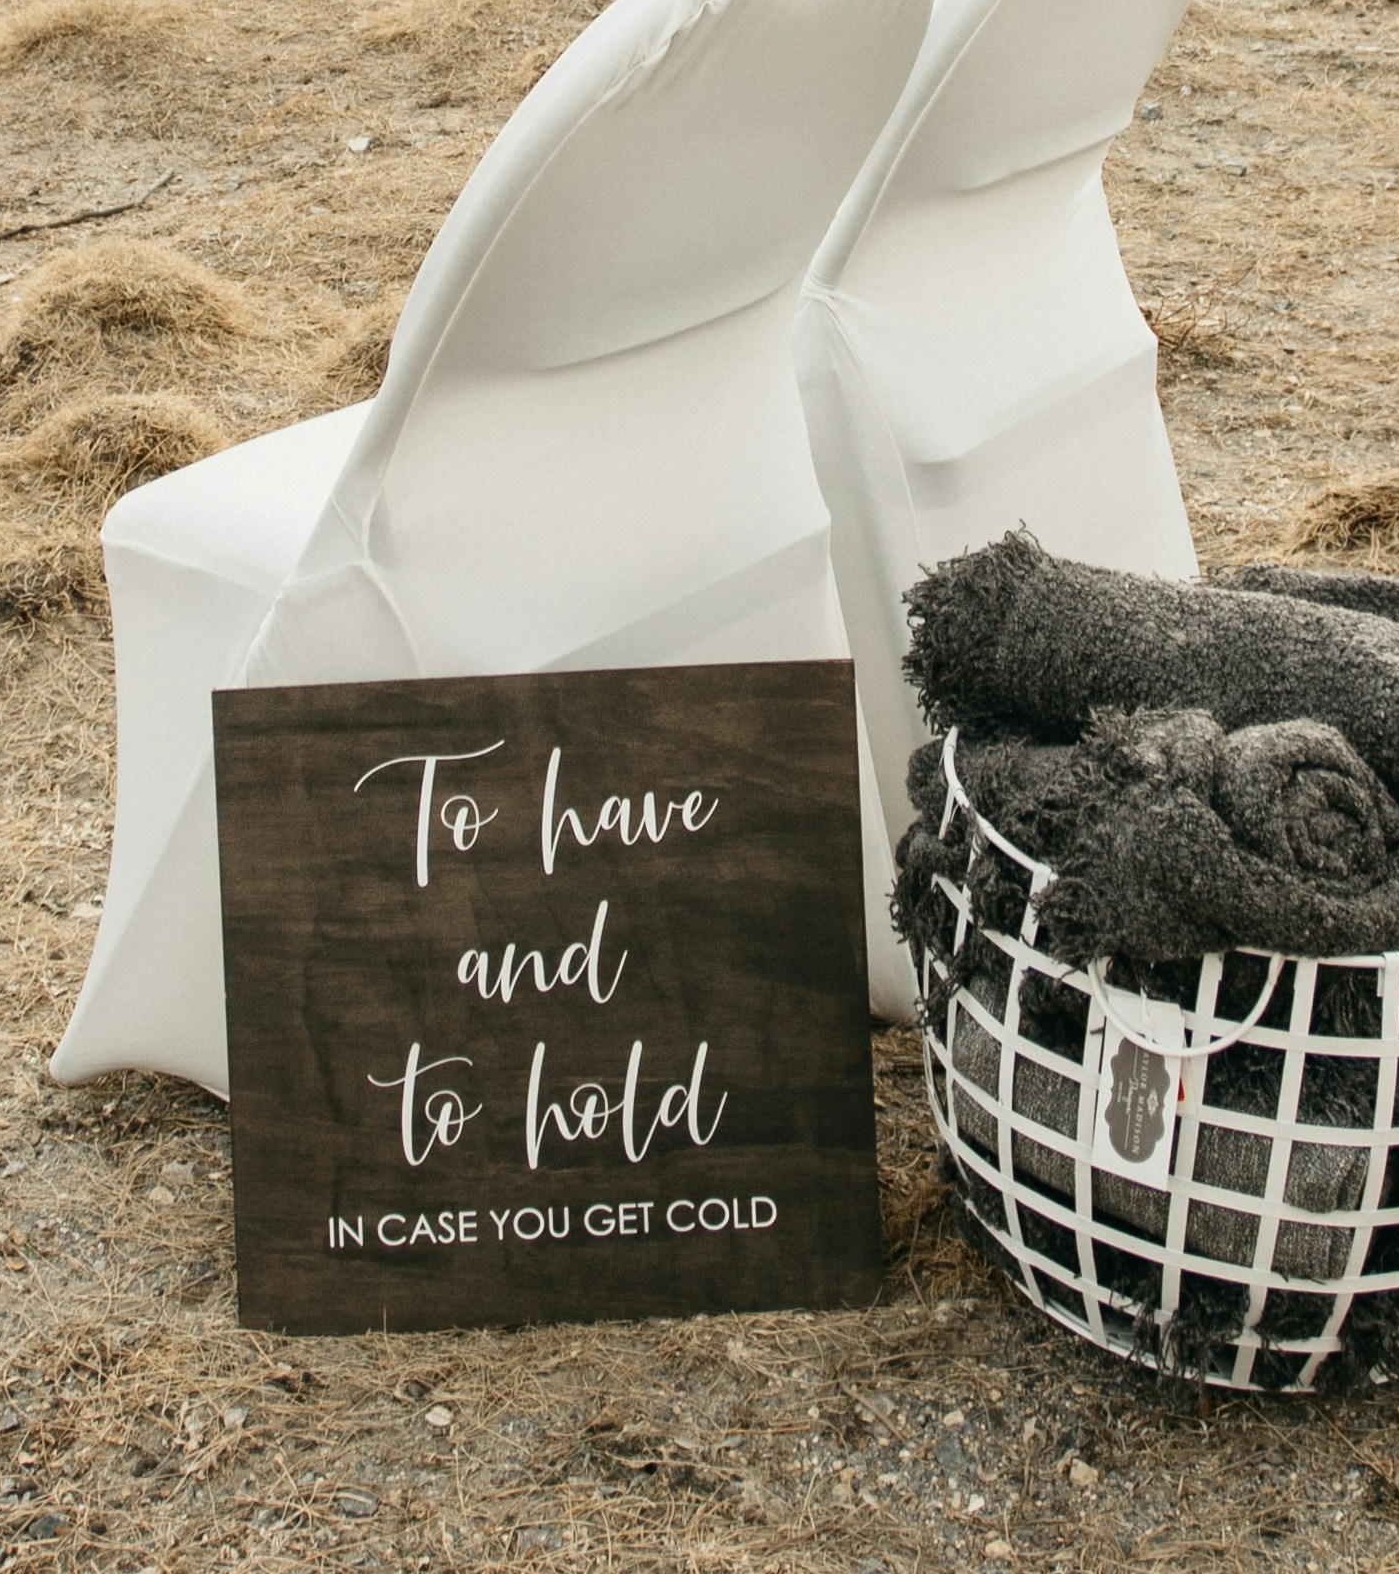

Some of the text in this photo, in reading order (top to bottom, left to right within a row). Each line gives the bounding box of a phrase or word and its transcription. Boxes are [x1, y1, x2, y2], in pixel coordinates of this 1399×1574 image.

[352, 738, 720, 888] To have
[456, 899, 629, 1004] and
[366, 1039, 728, 1171] to hold
[1132, 1095, 1145, 1155] MADISON
[328, 1196, 779, 1249] IN CASE YOU GET COLD
